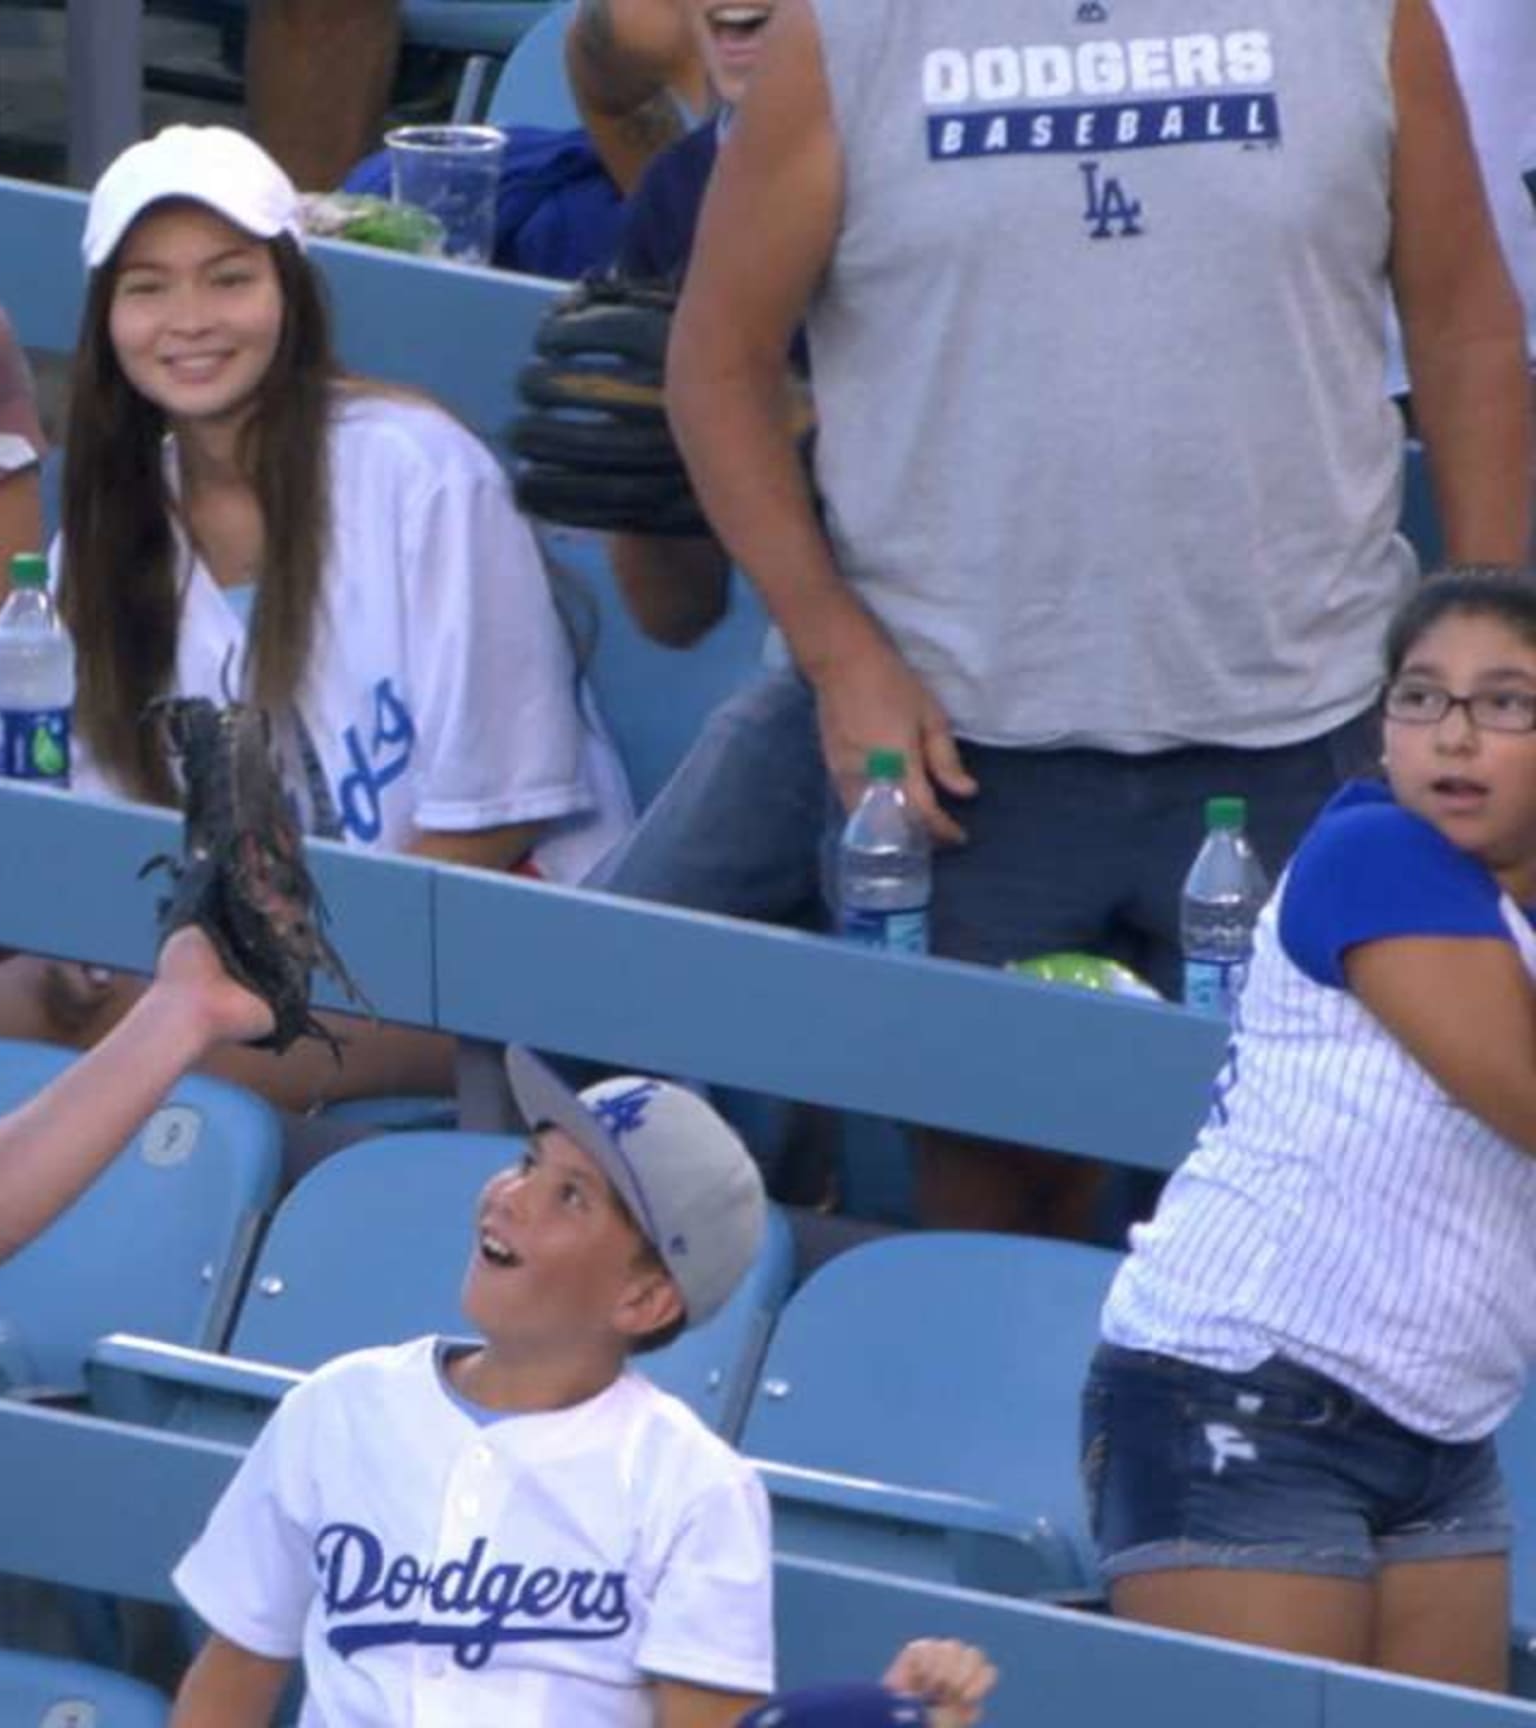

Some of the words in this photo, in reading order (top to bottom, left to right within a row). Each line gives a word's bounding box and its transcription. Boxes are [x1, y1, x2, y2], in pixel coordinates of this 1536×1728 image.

[921, 29, 1274, 104] DODGERS
[939, 100, 1265, 154] BASEBALL
[1077, 161, 1142, 239] LA
[316, 1522, 631, 1671] Dodgers
